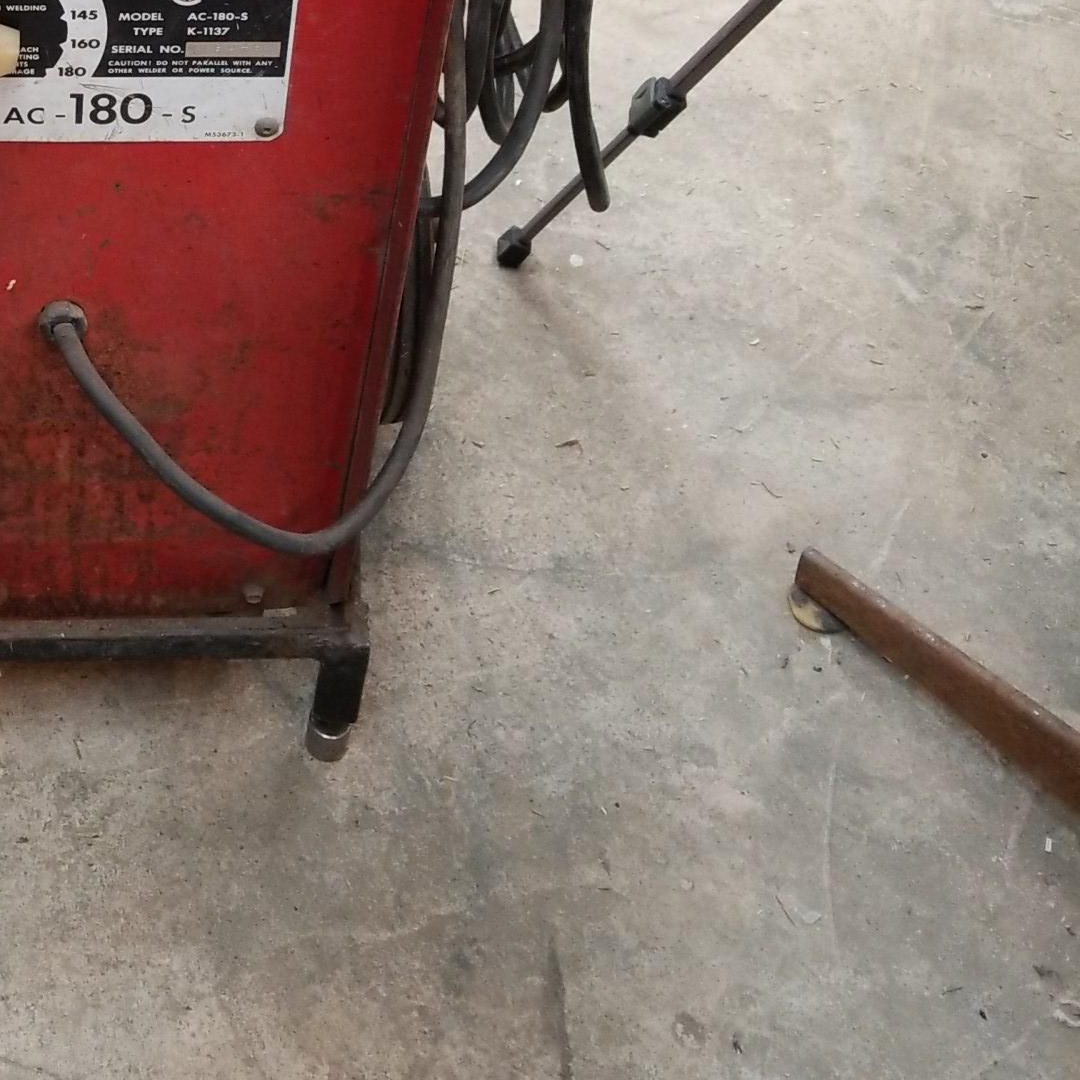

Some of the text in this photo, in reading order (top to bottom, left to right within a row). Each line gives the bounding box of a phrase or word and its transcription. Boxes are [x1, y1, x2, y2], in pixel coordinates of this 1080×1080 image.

[6, 4, 47, 12] WELDING
[70, 10, 98, 20] 145
[118, 12, 249, 21] MODEL AC-180-S
[133, 27, 230, 36] TYPE K-1137
[70, 39, 100, 49] 160
[111, 45, 184, 54] SERIAL NO.
[58, 67, 87, 77] 180
